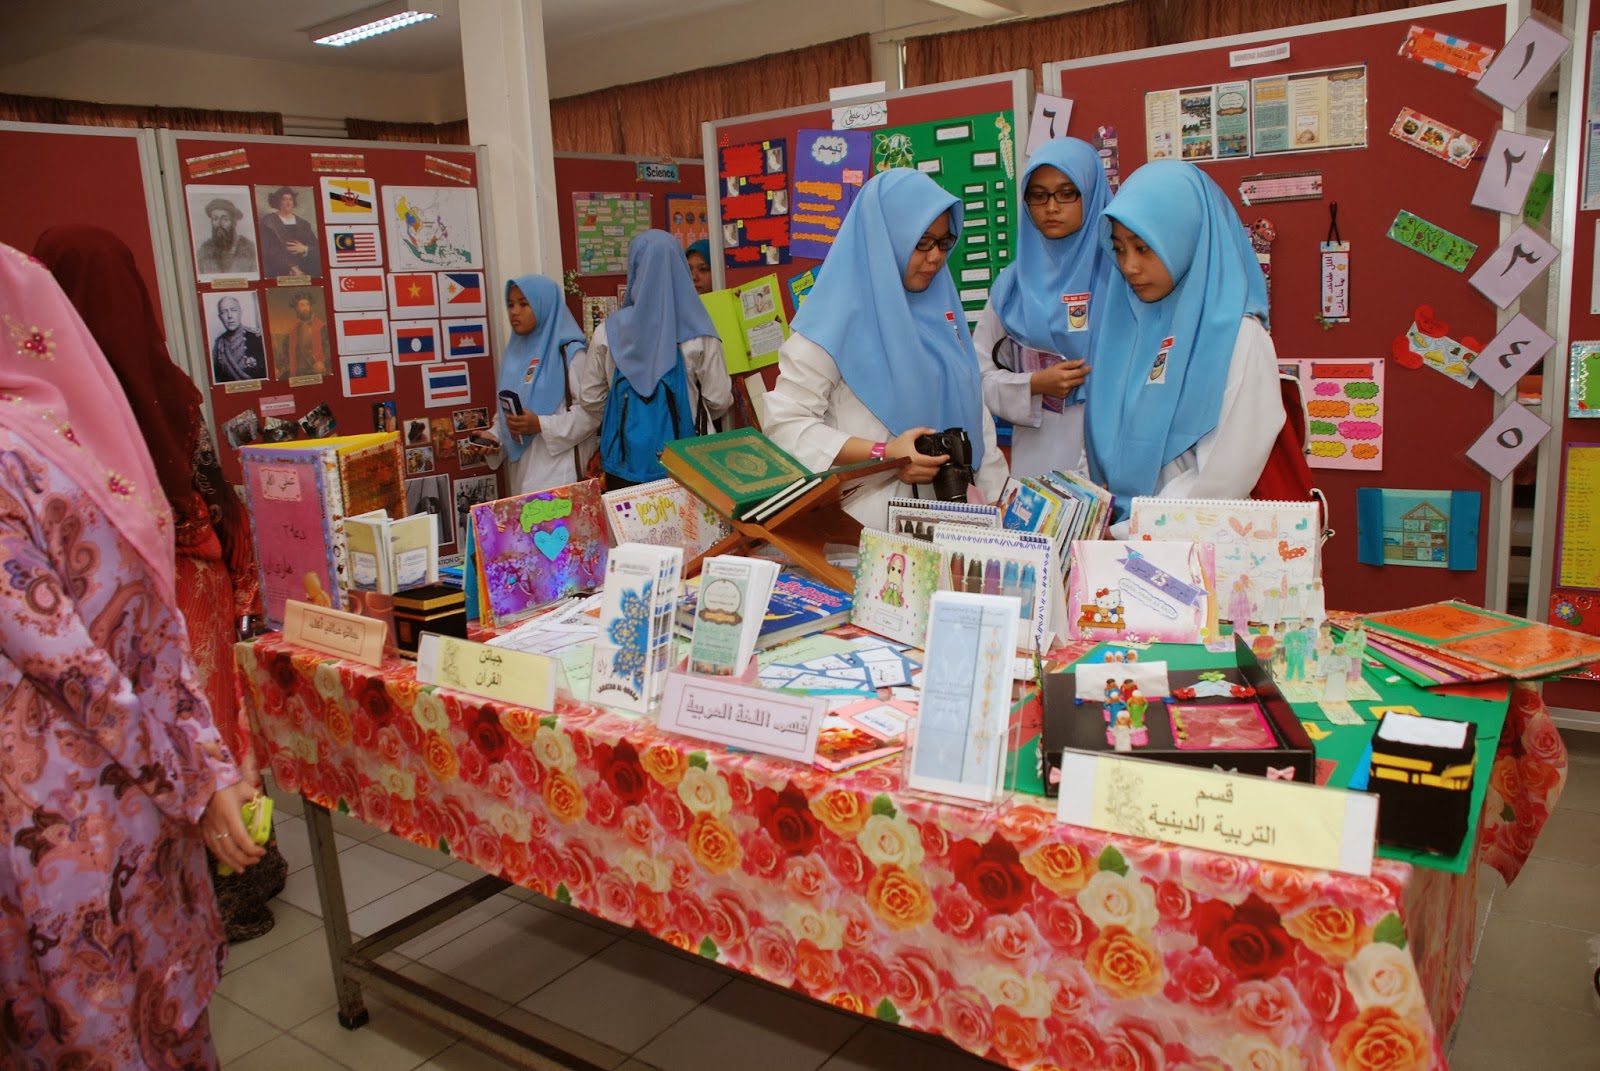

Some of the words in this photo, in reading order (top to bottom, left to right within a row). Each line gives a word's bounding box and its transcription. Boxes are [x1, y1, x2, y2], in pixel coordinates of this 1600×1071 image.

[1042, 107, 1056, 139] ٦
[645, 166, 676, 179] Science
[1503, 147, 1527, 188] ٢
[1500, 243, 1541, 277] ٣
[1498, 340, 1532, 369] ٤
[1496, 427, 1523, 448] ٥
[685, 694, 733, 720] العربية
[735, 703, 771, 728] اللغة
[1195, 782, 1234, 805] قسم
[1148, 804, 1205, 833] الدينية
[1212, 814, 1276, 846] التربية
